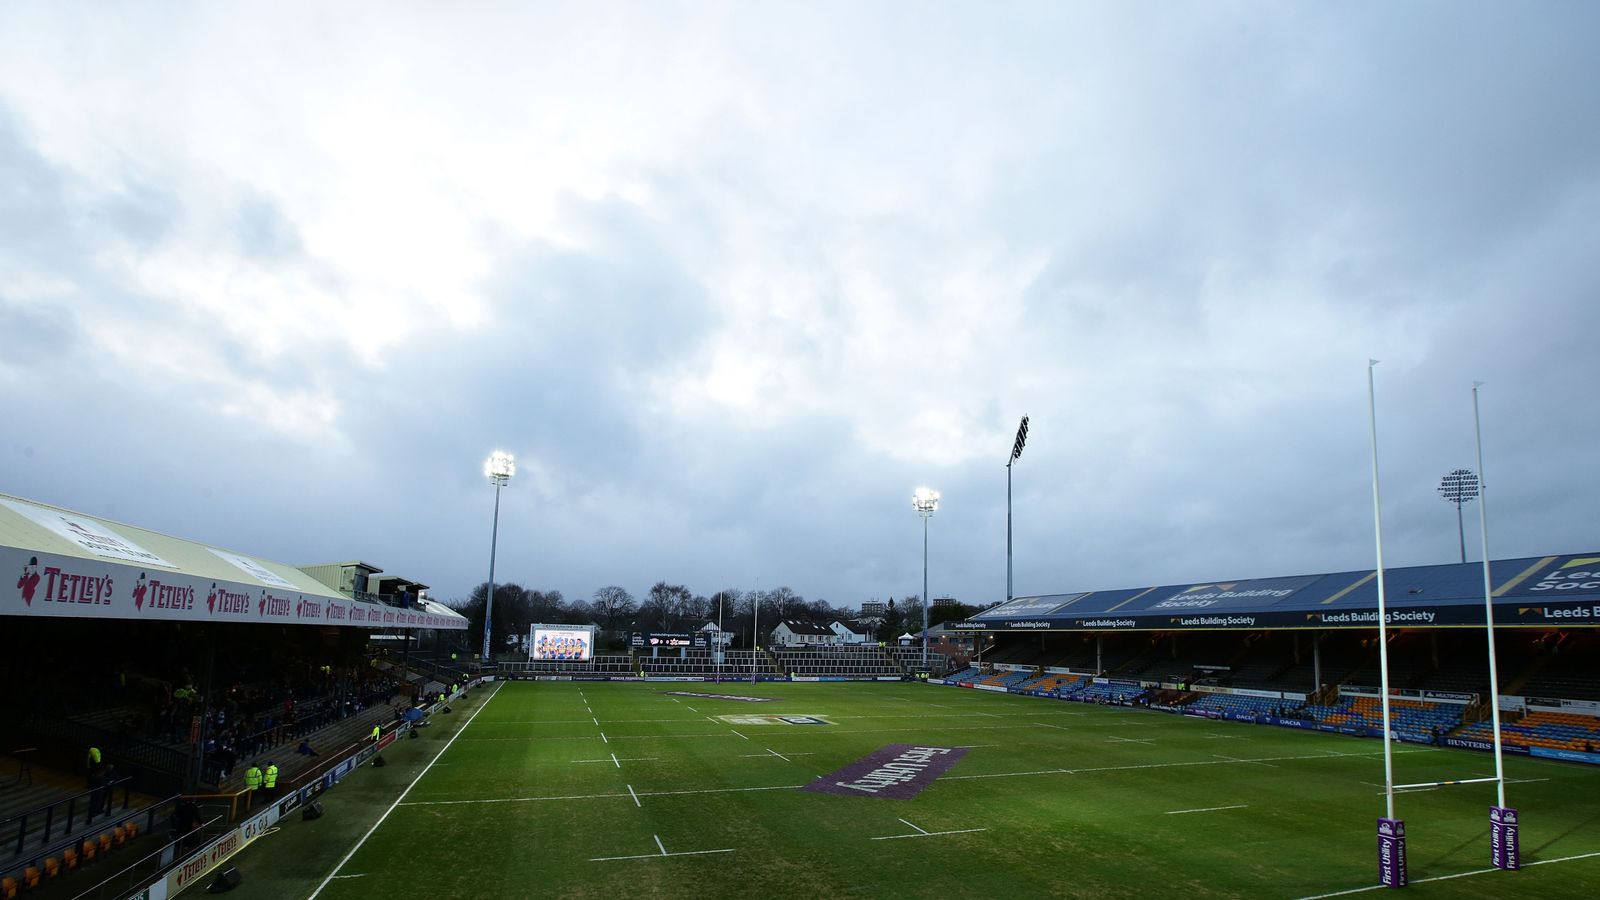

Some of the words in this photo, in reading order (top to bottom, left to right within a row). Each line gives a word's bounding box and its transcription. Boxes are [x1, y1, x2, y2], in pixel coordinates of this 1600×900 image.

[1169, 592, 1216, 601] Leeds
[1217, 588, 1294, 599] Building
[1156, 599, 1217, 608] Society
[1321, 613, 1350, 623] Leeds
[1351, 612, 1392, 623] Buildig
[1392, 611, 1435, 622] Society
[1543, 606, 1591, 618] Leeds
[1098, 620, 1116, 628] Building
[1116, 619, 1136, 628] Society
[1180, 616, 1200, 626] Leeds
[1200, 616, 1227, 626] Building
[1228, 616, 1255, 626] Society
[1447, 738, 1492, 750] HUNTERS
[1506, 827, 1516, 850] Utility
[1382, 838, 1392, 866] Utility
[1506, 851, 1516, 869] First
[1382, 866, 1392, 885] First
